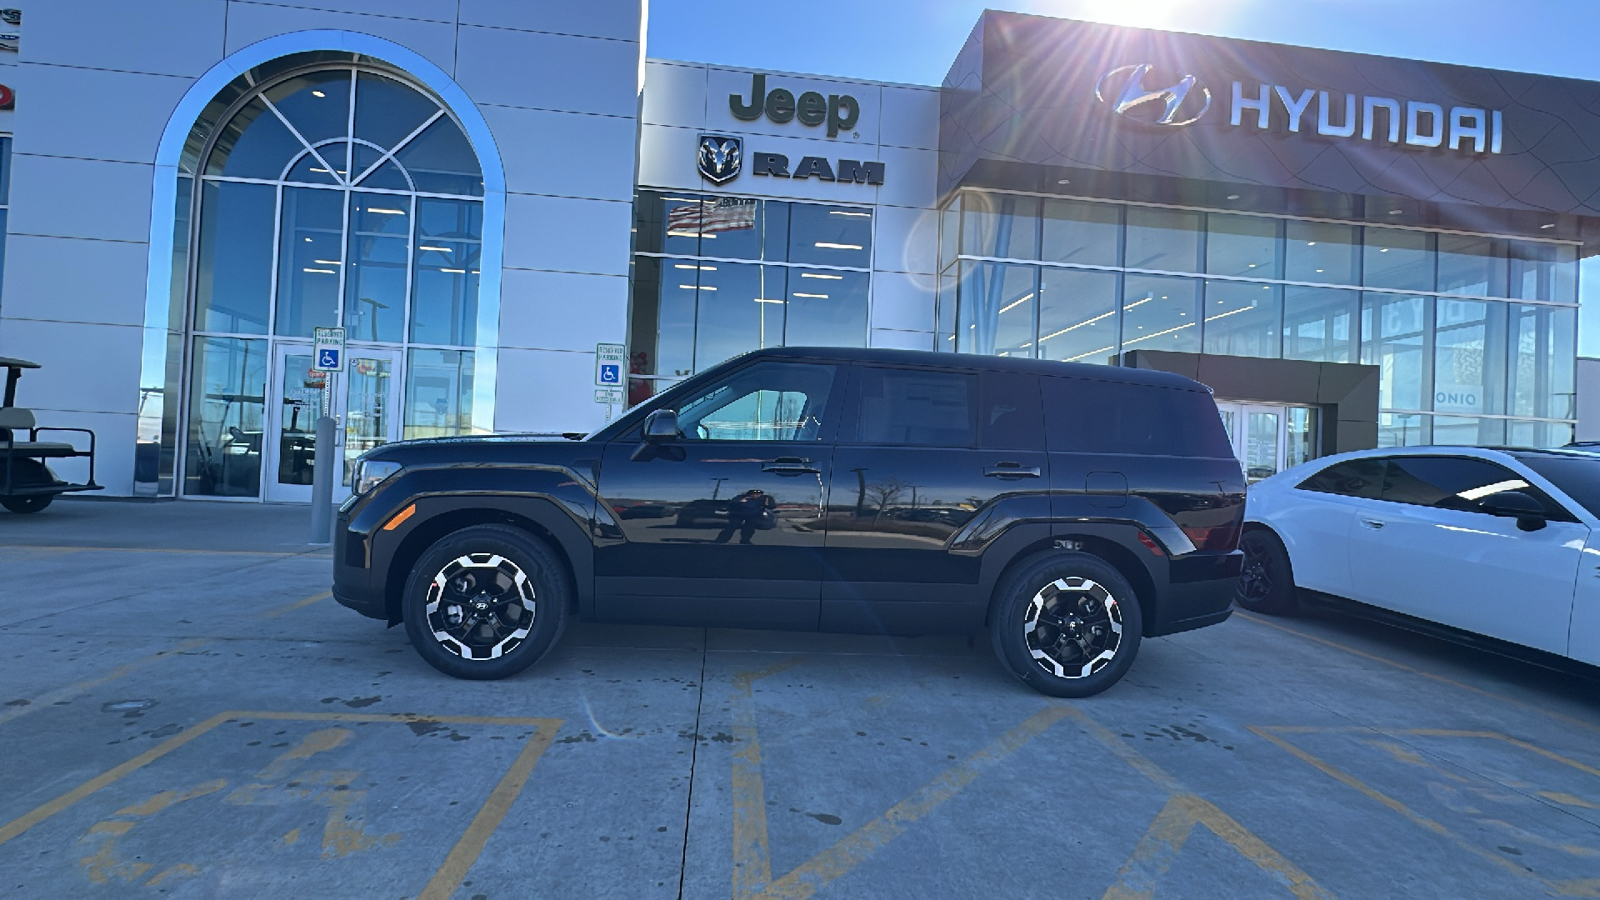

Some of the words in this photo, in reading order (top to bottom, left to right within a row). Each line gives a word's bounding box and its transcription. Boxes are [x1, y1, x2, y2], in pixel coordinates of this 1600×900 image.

[729, 73, 860, 138] Jeep
[1230, 81, 1502, 154] HYUNDAI
[753, 152, 885, 185] RAM
[599, 346, 623, 354] RESERVED
[1436, 391, 1476, 405] ONIQ
